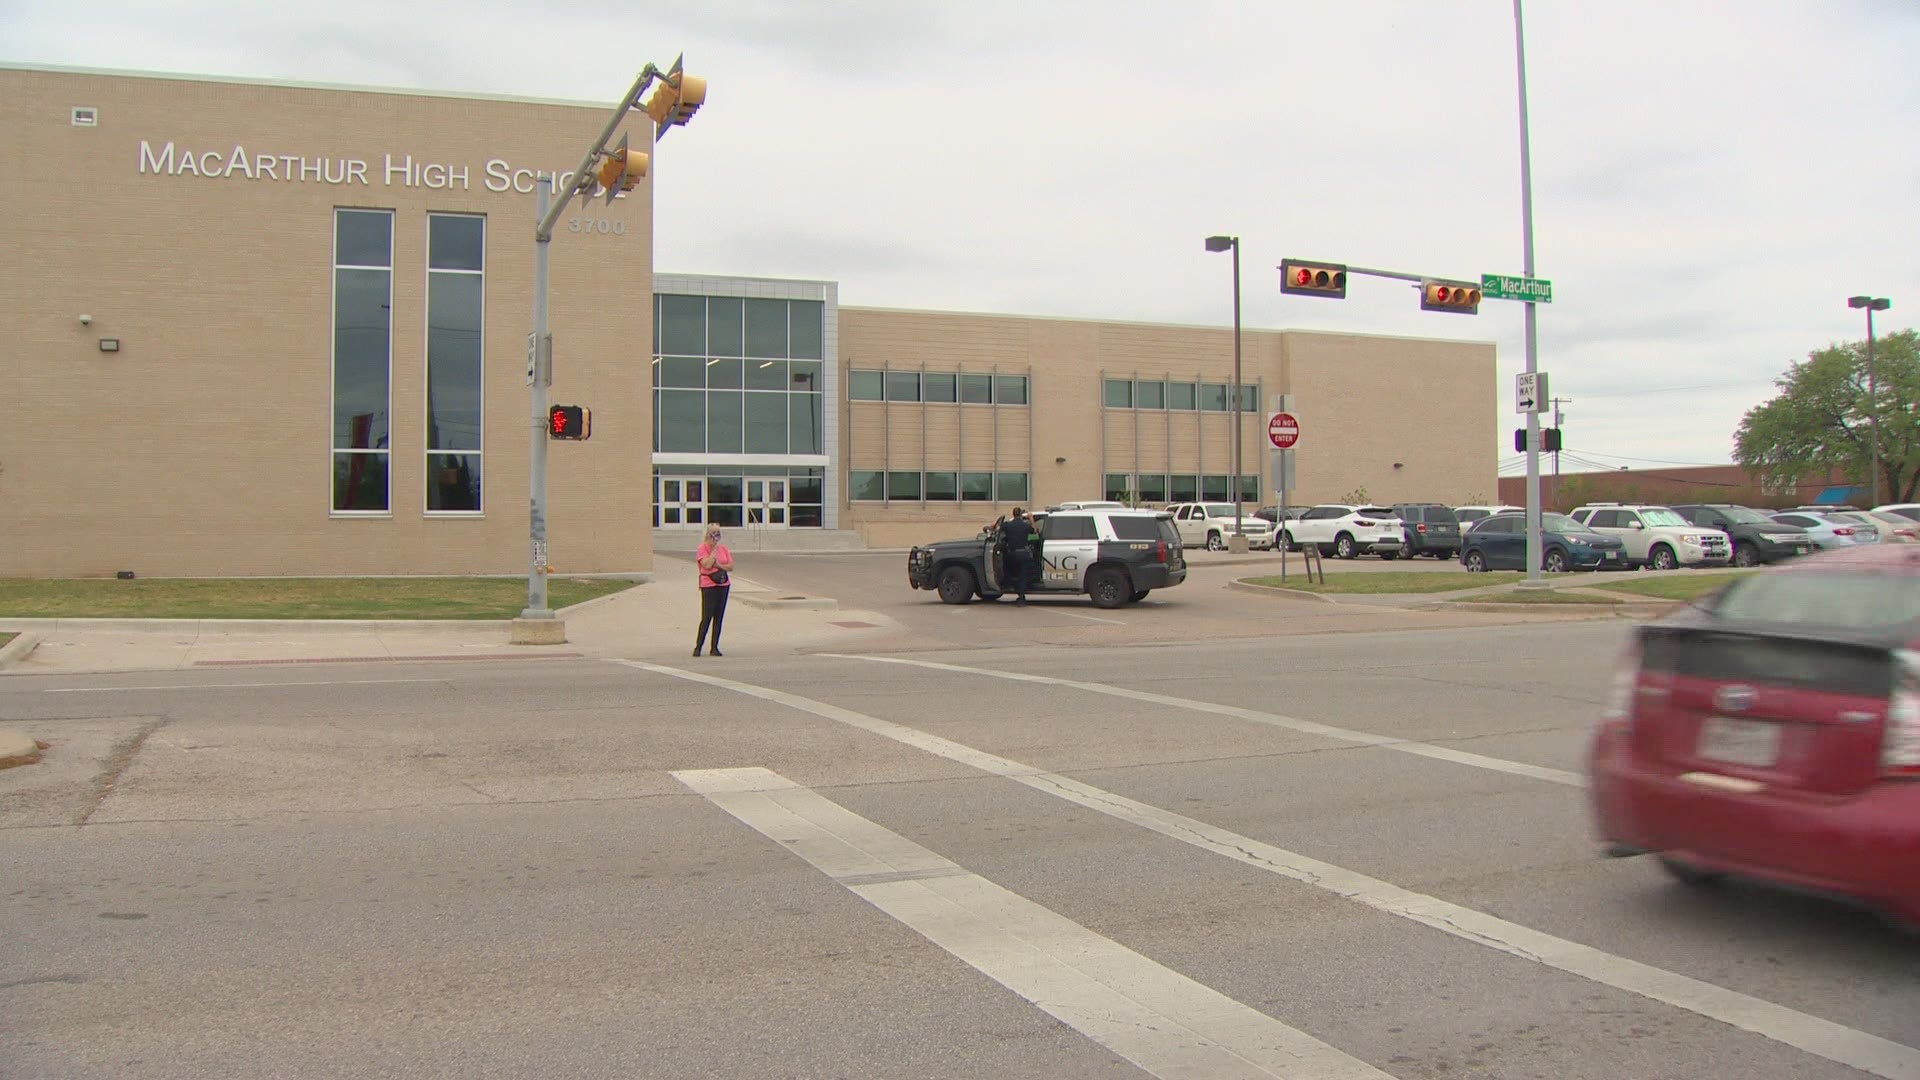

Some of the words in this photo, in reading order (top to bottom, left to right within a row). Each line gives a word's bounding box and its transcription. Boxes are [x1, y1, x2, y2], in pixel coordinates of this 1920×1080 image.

[568, 215, 627, 236] 3700
[1500, 276, 1551, 297] MacArthur
[1519, 375, 1534, 386] ONE
[1519, 385, 1535, 396] WAY
[1274, 434, 1293, 442] ENTER
